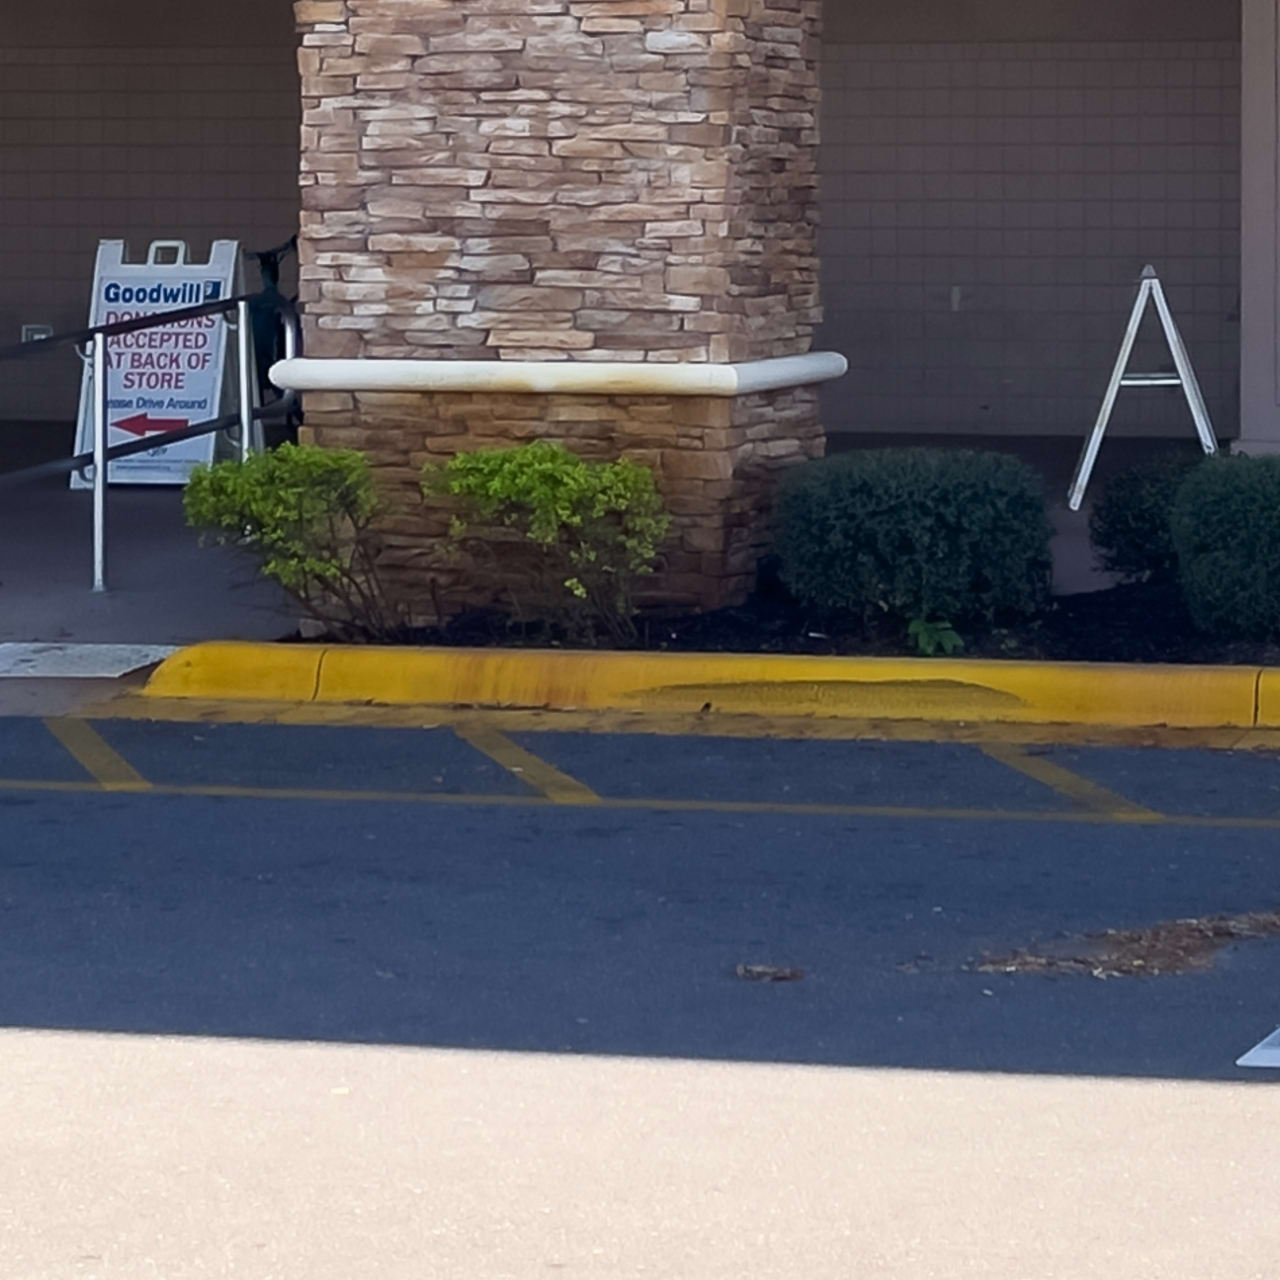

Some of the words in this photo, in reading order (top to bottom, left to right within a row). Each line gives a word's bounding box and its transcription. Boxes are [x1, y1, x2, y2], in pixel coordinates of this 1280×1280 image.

[104, 282, 201, 304] Goodwill
[109, 331, 208, 349] ACCEPTED
[130, 352, 182, 369] BACK
[187, 352, 213, 370] OF
[123, 371, 186, 389] STORE
[136, 396, 165, 409] Drive
[166, 397, 208, 409] Around
